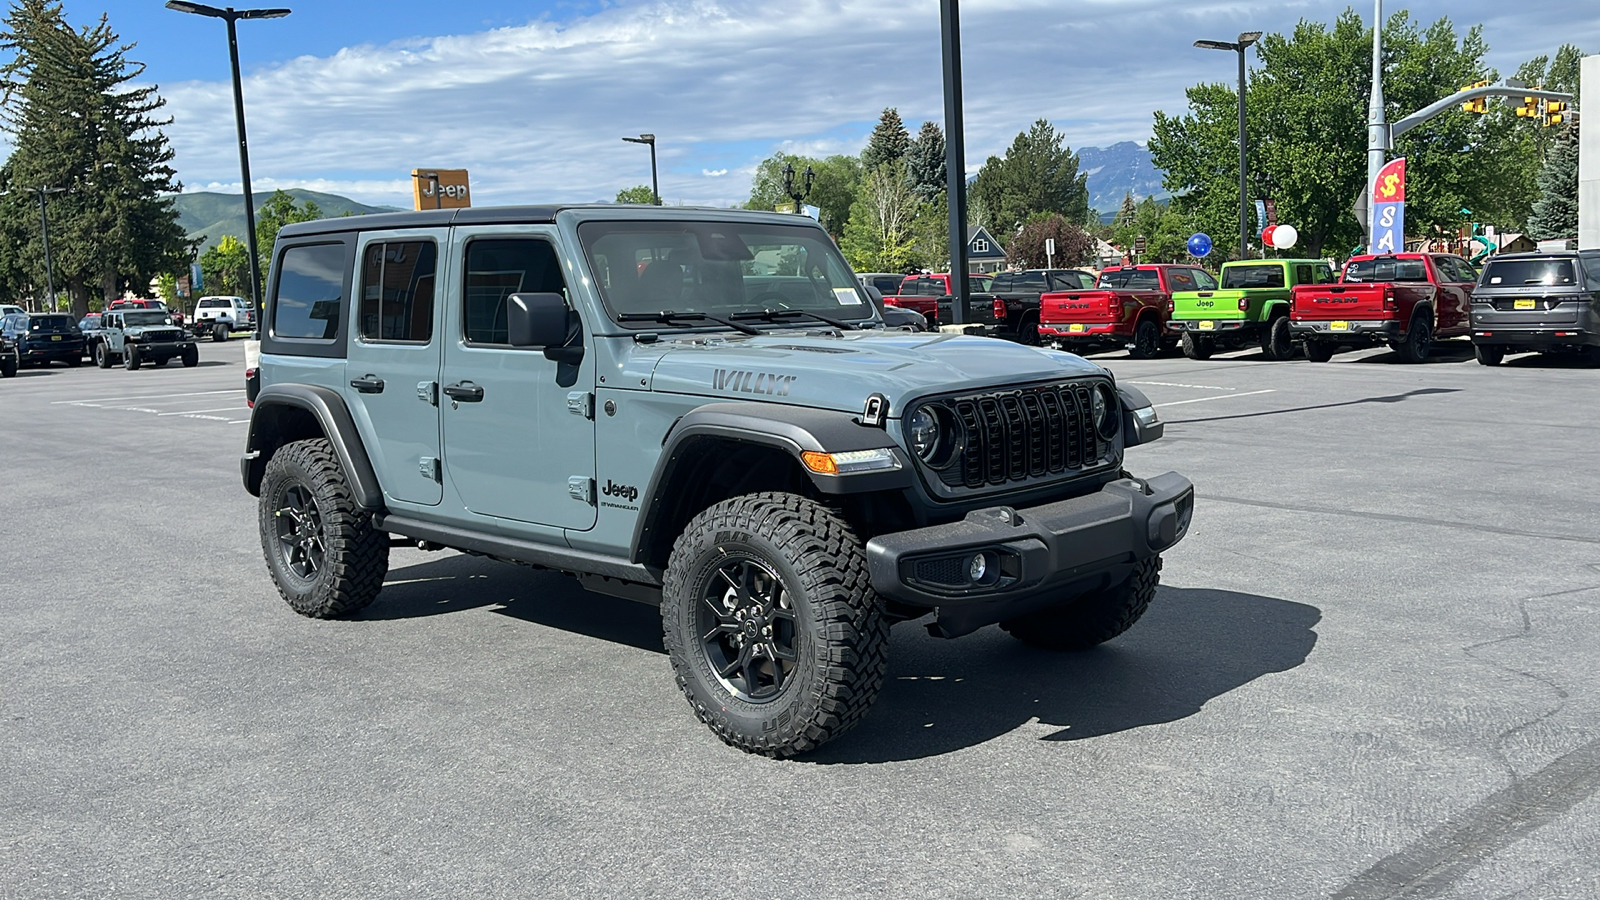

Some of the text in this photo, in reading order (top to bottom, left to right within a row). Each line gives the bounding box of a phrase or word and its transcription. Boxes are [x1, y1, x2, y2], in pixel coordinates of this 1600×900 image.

[423, 181, 467, 200] Jeep
[713, 369, 797, 396] WILLYS
[602, 479, 638, 502] Jeep
[606, 502, 639, 511] WRANGLER
[714, 530, 752, 545] M/T
